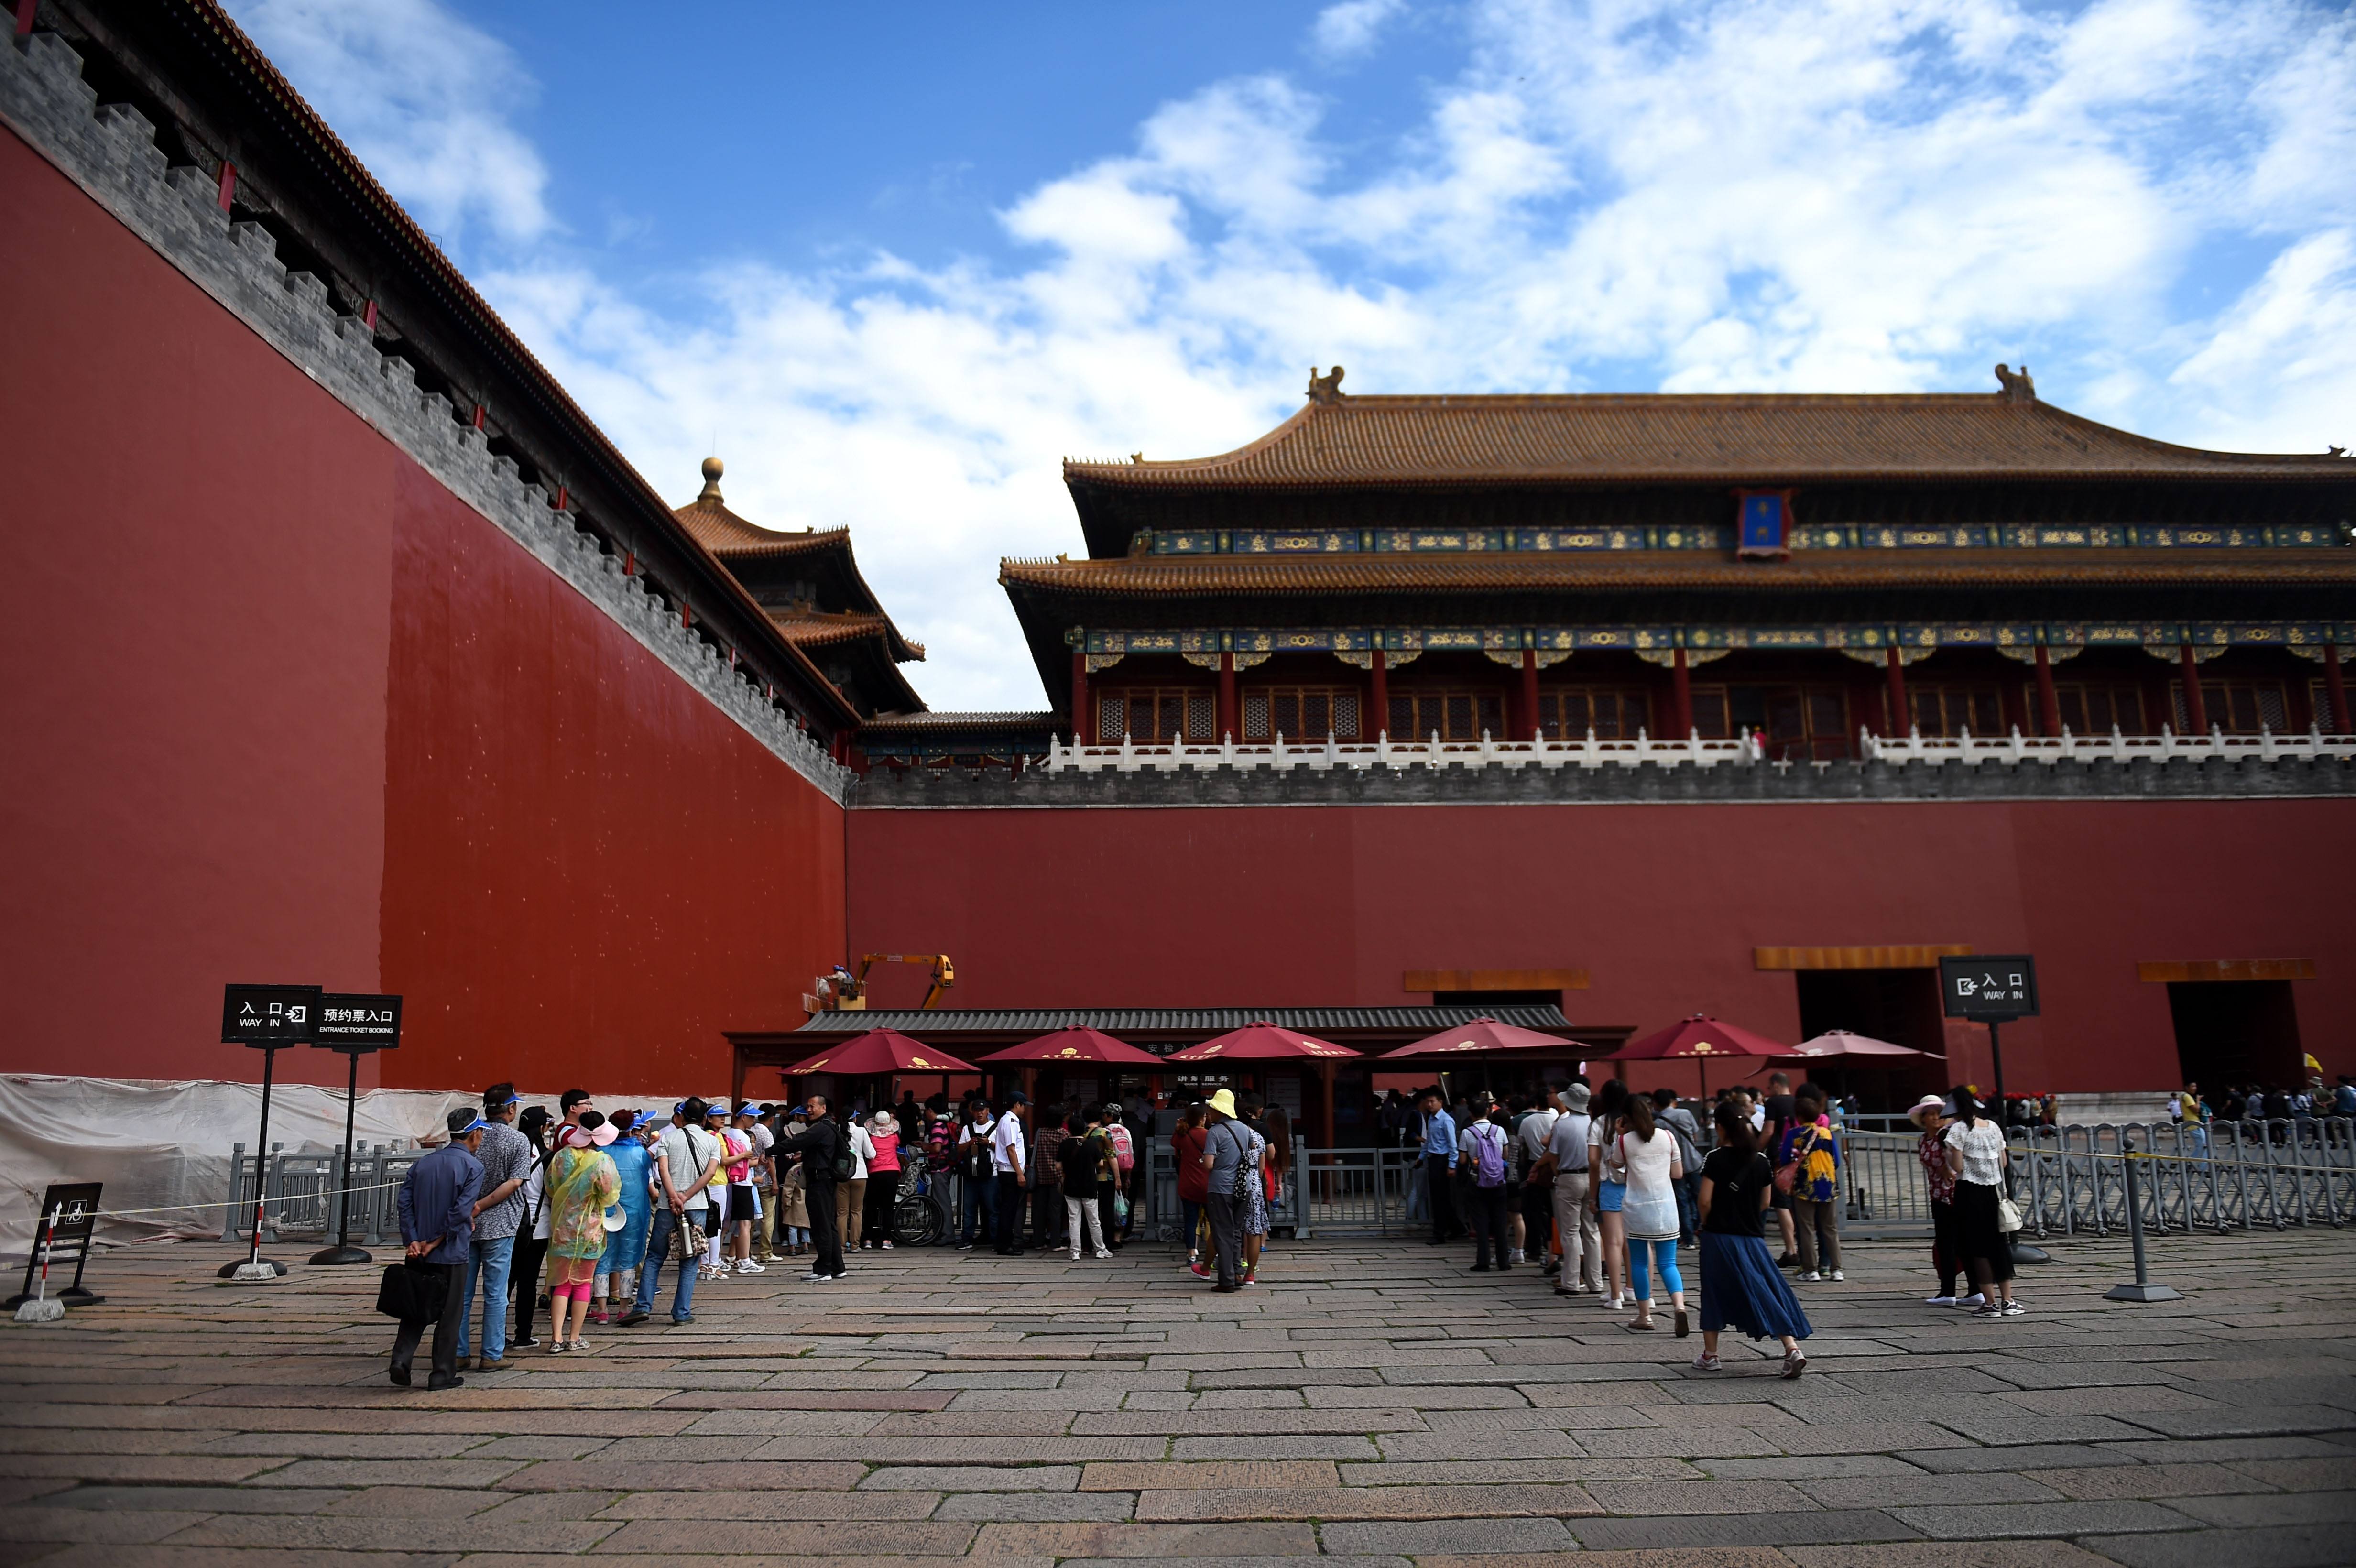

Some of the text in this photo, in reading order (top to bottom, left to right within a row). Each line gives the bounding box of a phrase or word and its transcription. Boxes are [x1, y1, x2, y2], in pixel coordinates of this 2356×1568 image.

[1982, 973, 2022, 987] 入口
[1983, 990, 2023, 1000] WAY IN
[240, 1001, 282, 1015] 入口
[324, 1009, 393, 1023] 预约票入口
[240, 1018, 280, 1027] WAY IN
[1148, 1044, 1199, 1053] 安检入
